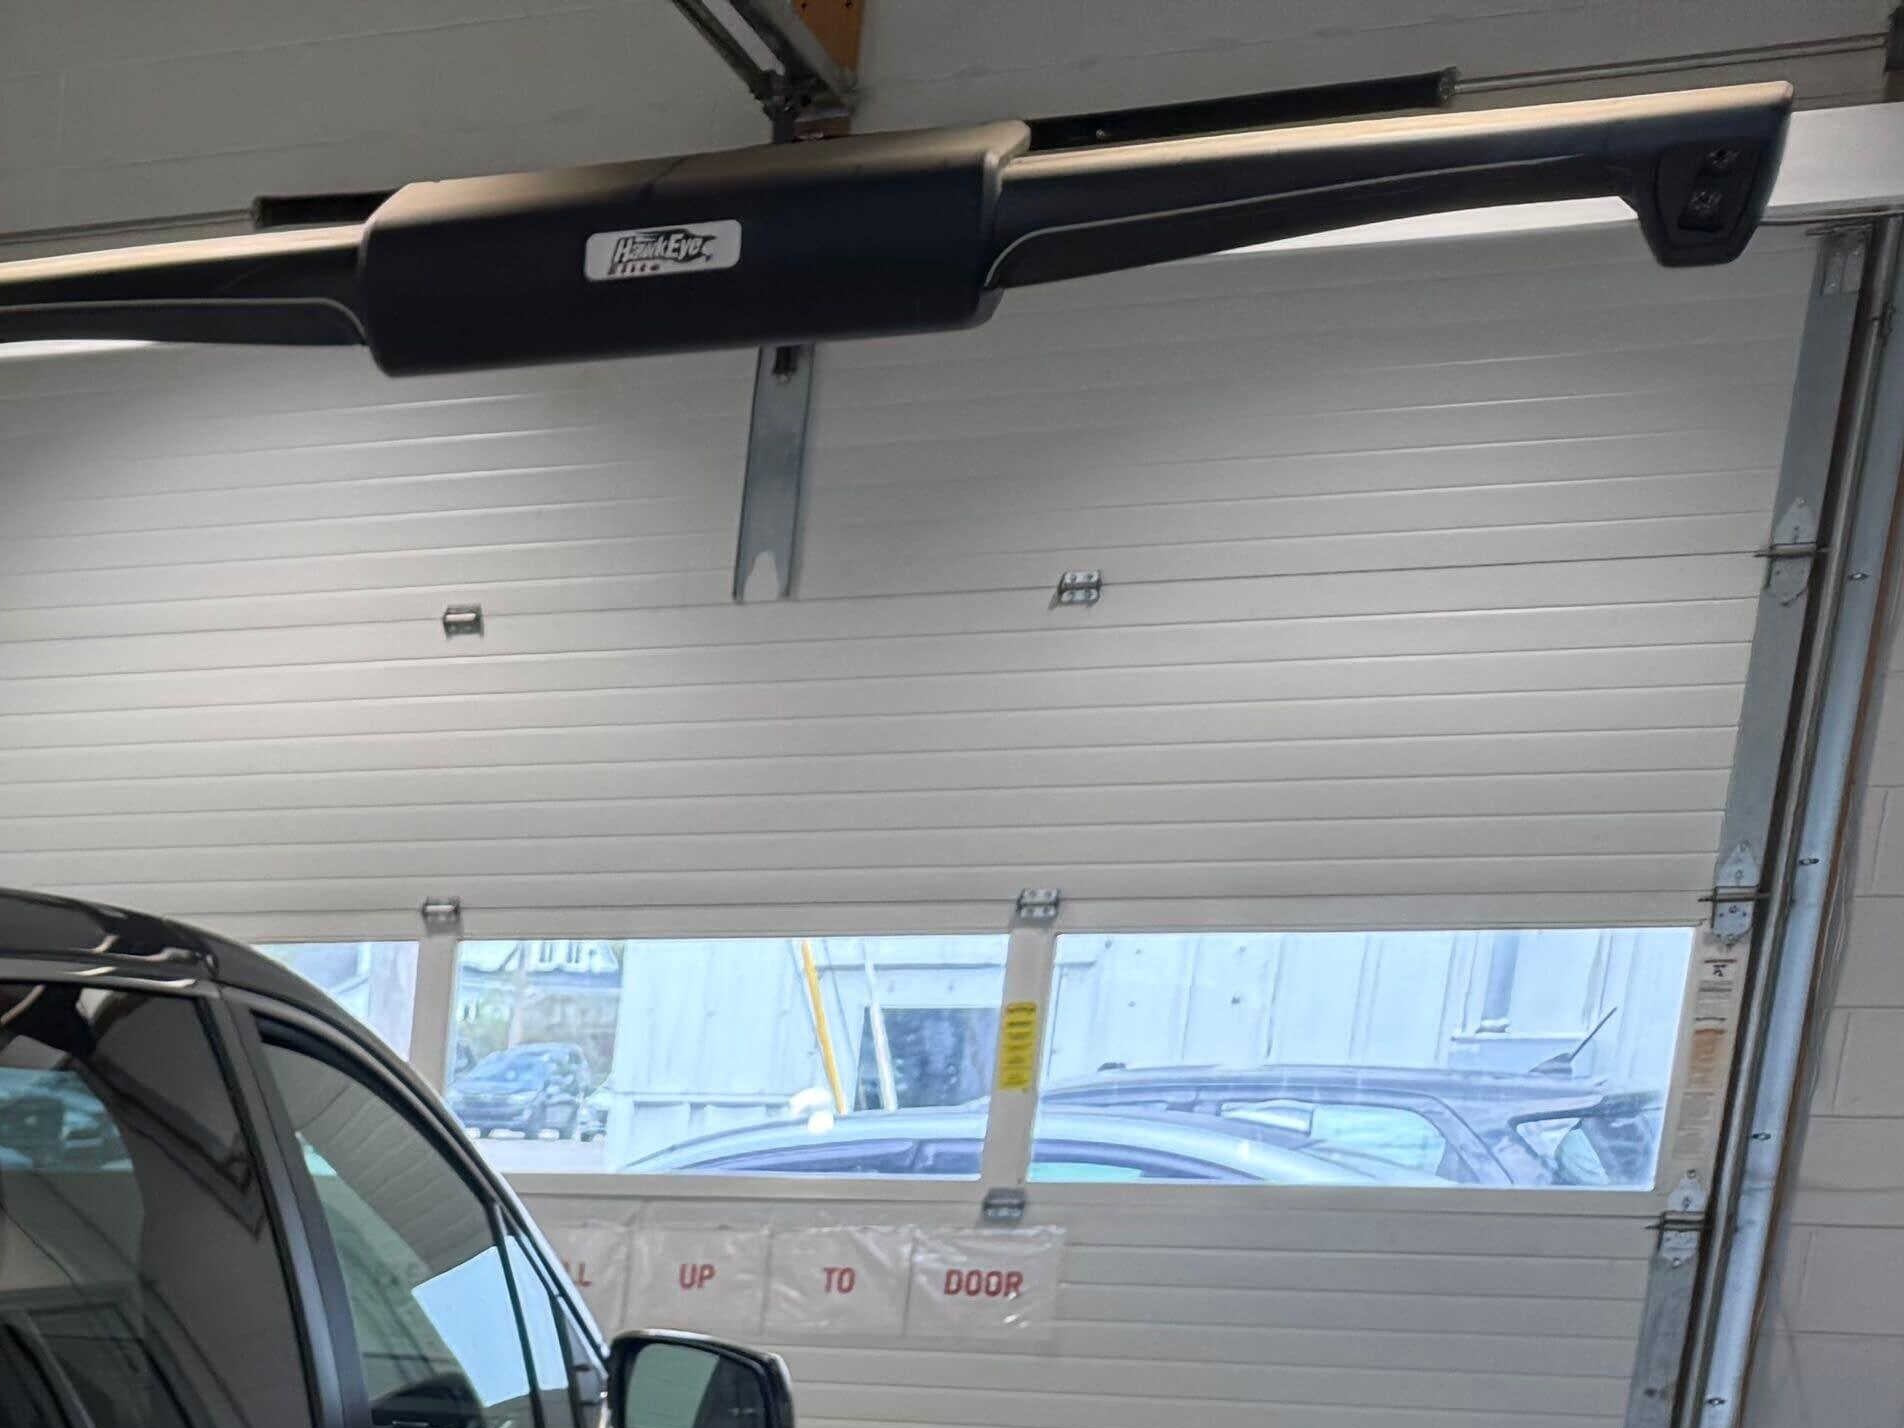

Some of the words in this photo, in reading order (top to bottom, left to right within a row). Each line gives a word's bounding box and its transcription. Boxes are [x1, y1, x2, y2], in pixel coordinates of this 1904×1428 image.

[613, 232, 705, 263] HawkEye
[679, 1263, 717, 1290] UP
[823, 1266, 856, 1294] TO
[944, 1268, 1024, 1297] DOOR
